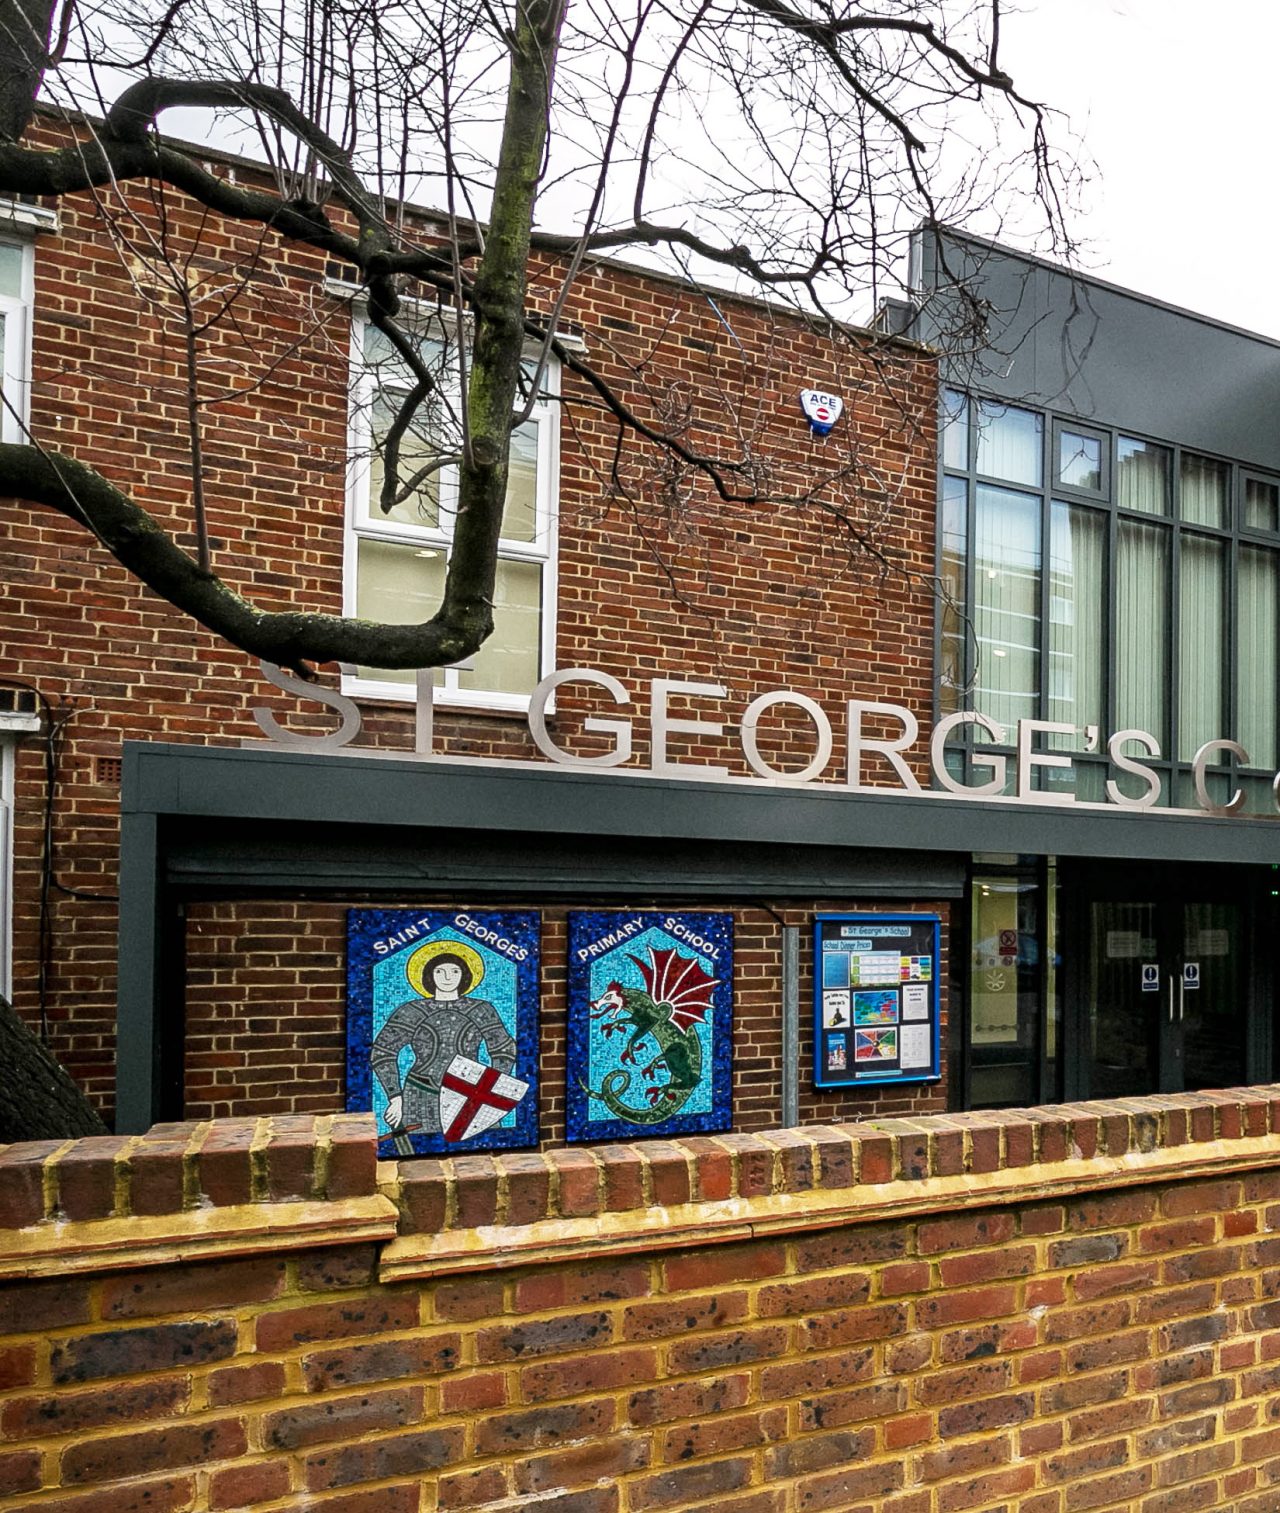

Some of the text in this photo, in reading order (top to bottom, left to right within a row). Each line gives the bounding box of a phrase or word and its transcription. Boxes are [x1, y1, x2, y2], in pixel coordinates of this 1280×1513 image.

[810, 394, 837, 408] ACE
[252, 660, 474, 754] ST
[528, 667, 1162, 808] GEORGE'S
[1192, 738, 1250, 814] C
[373, 914, 529, 962] SAINT GEORGES
[577, 916, 721, 962] PRIMARY SCHOOL
